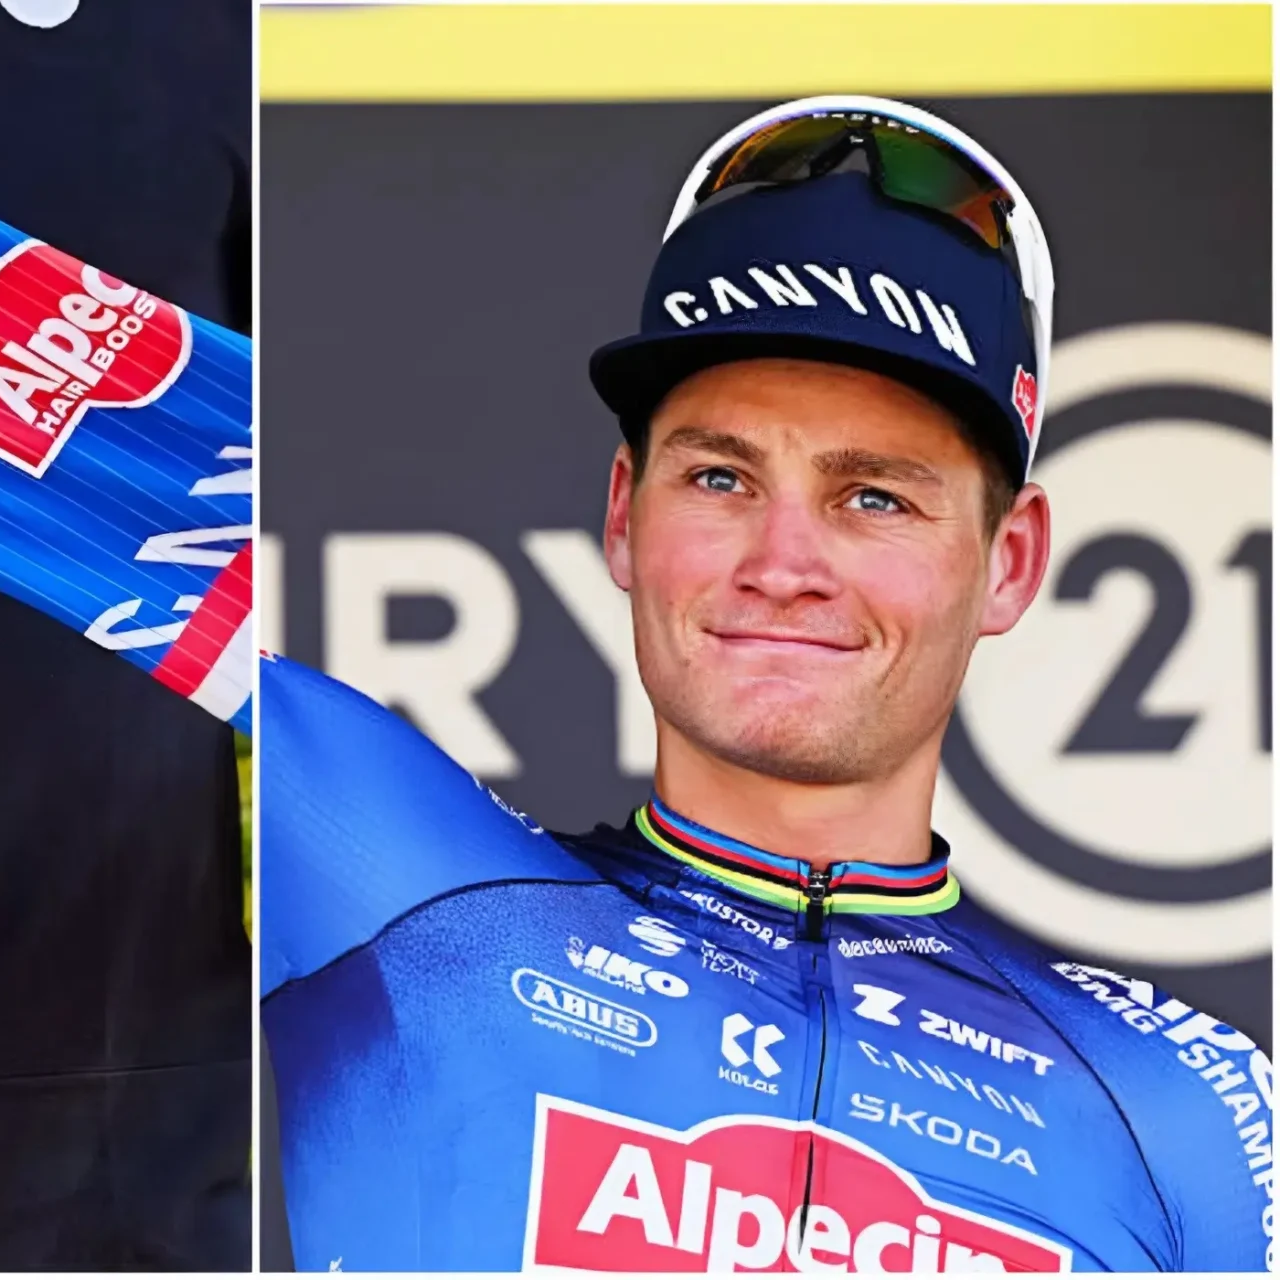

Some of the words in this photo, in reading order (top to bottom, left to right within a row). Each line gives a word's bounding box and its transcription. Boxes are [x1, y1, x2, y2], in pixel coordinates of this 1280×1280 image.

[664, 264, 976, 367] CANYON
[37, 381, 91, 433] HAIR
[584, 945, 690, 998] IKO
[532, 981, 640, 1038] ABUS
[920, 1009, 1054, 1076] ZWIFT
[857, 1040, 1046, 1128] CANYON
